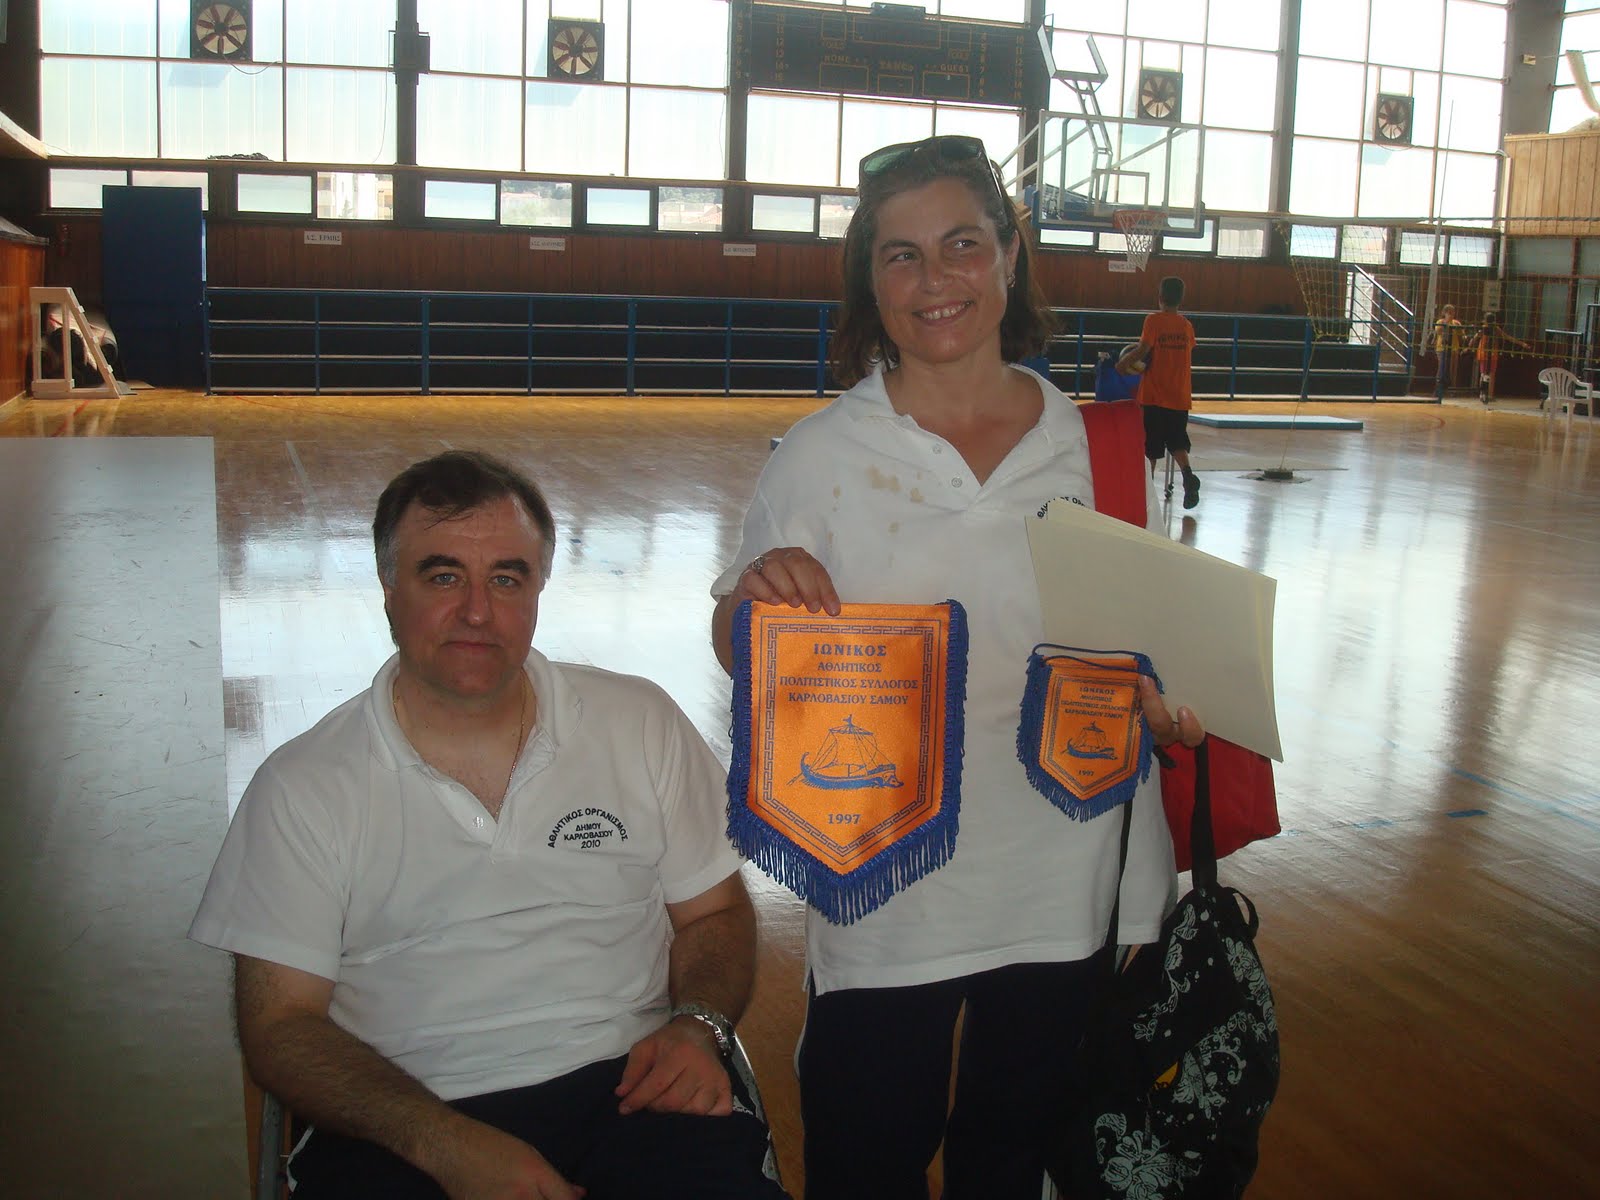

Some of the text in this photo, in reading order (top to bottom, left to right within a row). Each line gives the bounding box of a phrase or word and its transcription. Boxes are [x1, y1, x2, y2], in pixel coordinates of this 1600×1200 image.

[824, 55, 849, 64] HOME
[940, 63, 969, 73] GUEST
[814, 644, 887, 657] ΙΩΝΙΚΟΣ
[817, 661, 882, 673] ΑΘΛΗΤΙΚΟΣ
[779, 676, 918, 690] ΠΟΛΙΤΙΣΤΙΚΟΣ ΣΥΛΛΟΓΟΣ
[788, 692, 909, 705] ΚΑΡΛΟΒΑΣΙΟΥ ΣΑΜΟΥ
[827, 813, 862, 825] 1997
[548, 808, 628, 848] ΑΘΛΗΤΙΚΟΣ ΟΡΓΑΝΙΣΜΟΣ
[576, 822, 602, 832] ΔΗΜΟΥ
[564, 830, 614, 841] ΚΑΡΛΟΒΑΣΙΟΥ
[580, 840, 600, 849] 2010
